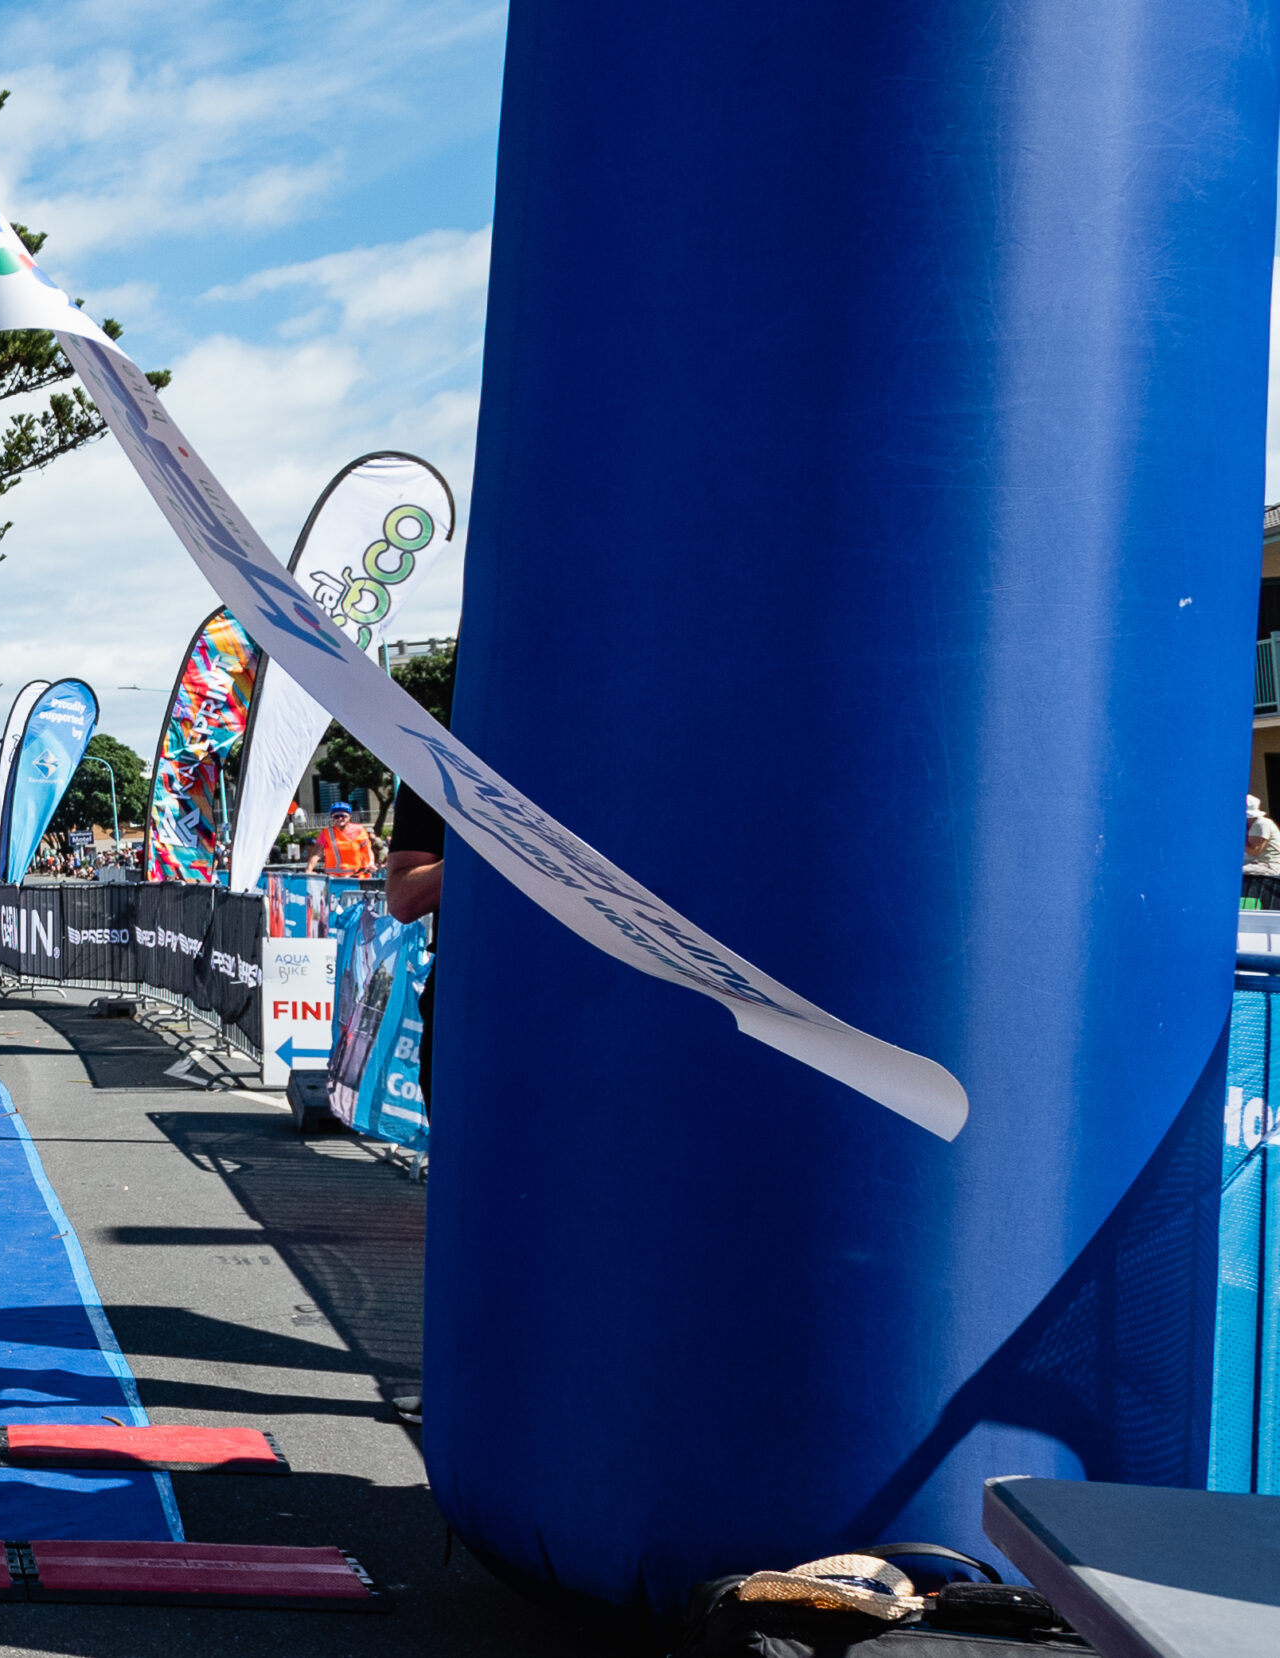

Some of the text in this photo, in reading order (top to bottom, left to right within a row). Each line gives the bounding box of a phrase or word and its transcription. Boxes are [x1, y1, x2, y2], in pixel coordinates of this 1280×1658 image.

[50, 697, 86, 715] Proudly
[39, 711, 85, 726] supported
[72, 727, 83, 740] by
[275, 954, 310, 966] AQUA
[278, 966, 308, 985] BIKE
[273, 1001, 331, 1021] FINI
